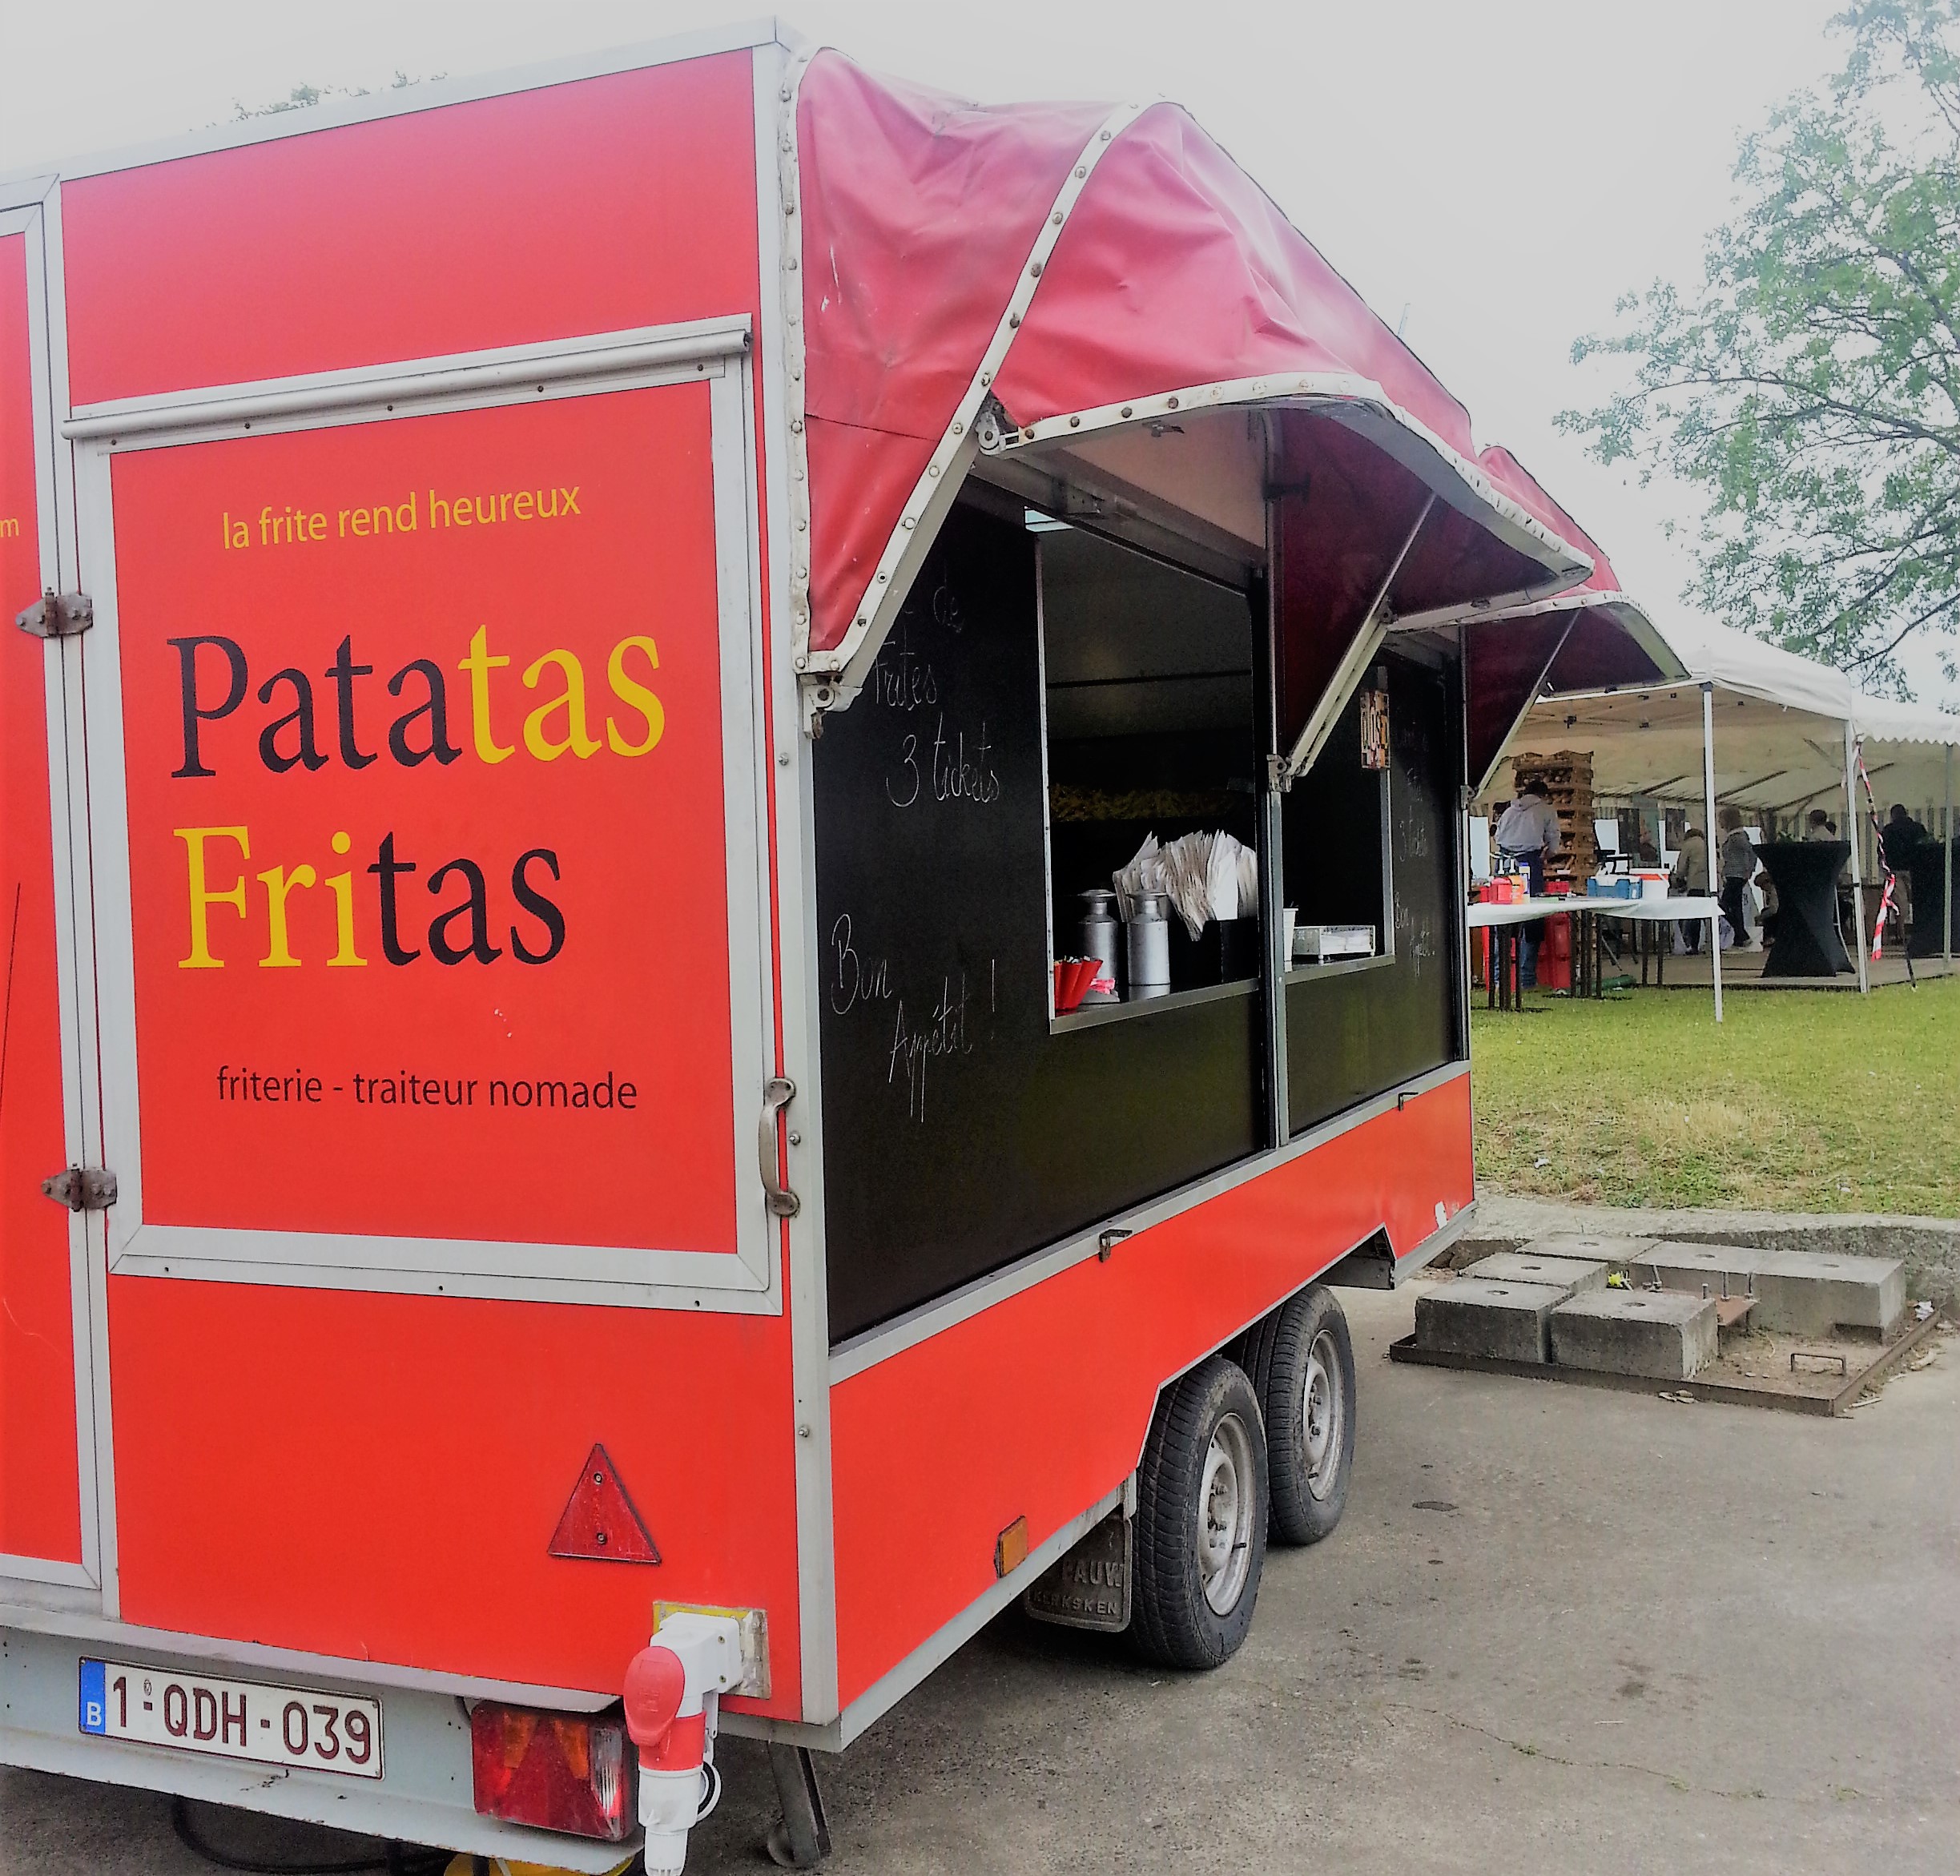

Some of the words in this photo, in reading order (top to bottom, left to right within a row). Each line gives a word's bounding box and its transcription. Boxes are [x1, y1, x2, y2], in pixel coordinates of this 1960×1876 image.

[223, 512, 250, 550] la
[259, 505, 328, 546] frite
[338, 491, 418, 539] rend
[429, 486, 582, 530] heureux
[167, 624, 666, 779] Patatas
[886, 734, 920, 807] 3
[933, 711, 1000, 803] tickets
[172, 825, 565, 969] Fritas
[831, 913, 892, 1015] Bon
[216, 1065, 322, 1103] friterie
[352, 1069, 478, 1106] traiteur
[489, 1070, 638, 1109] nomade
[86, 1701, 103, 1728] B
